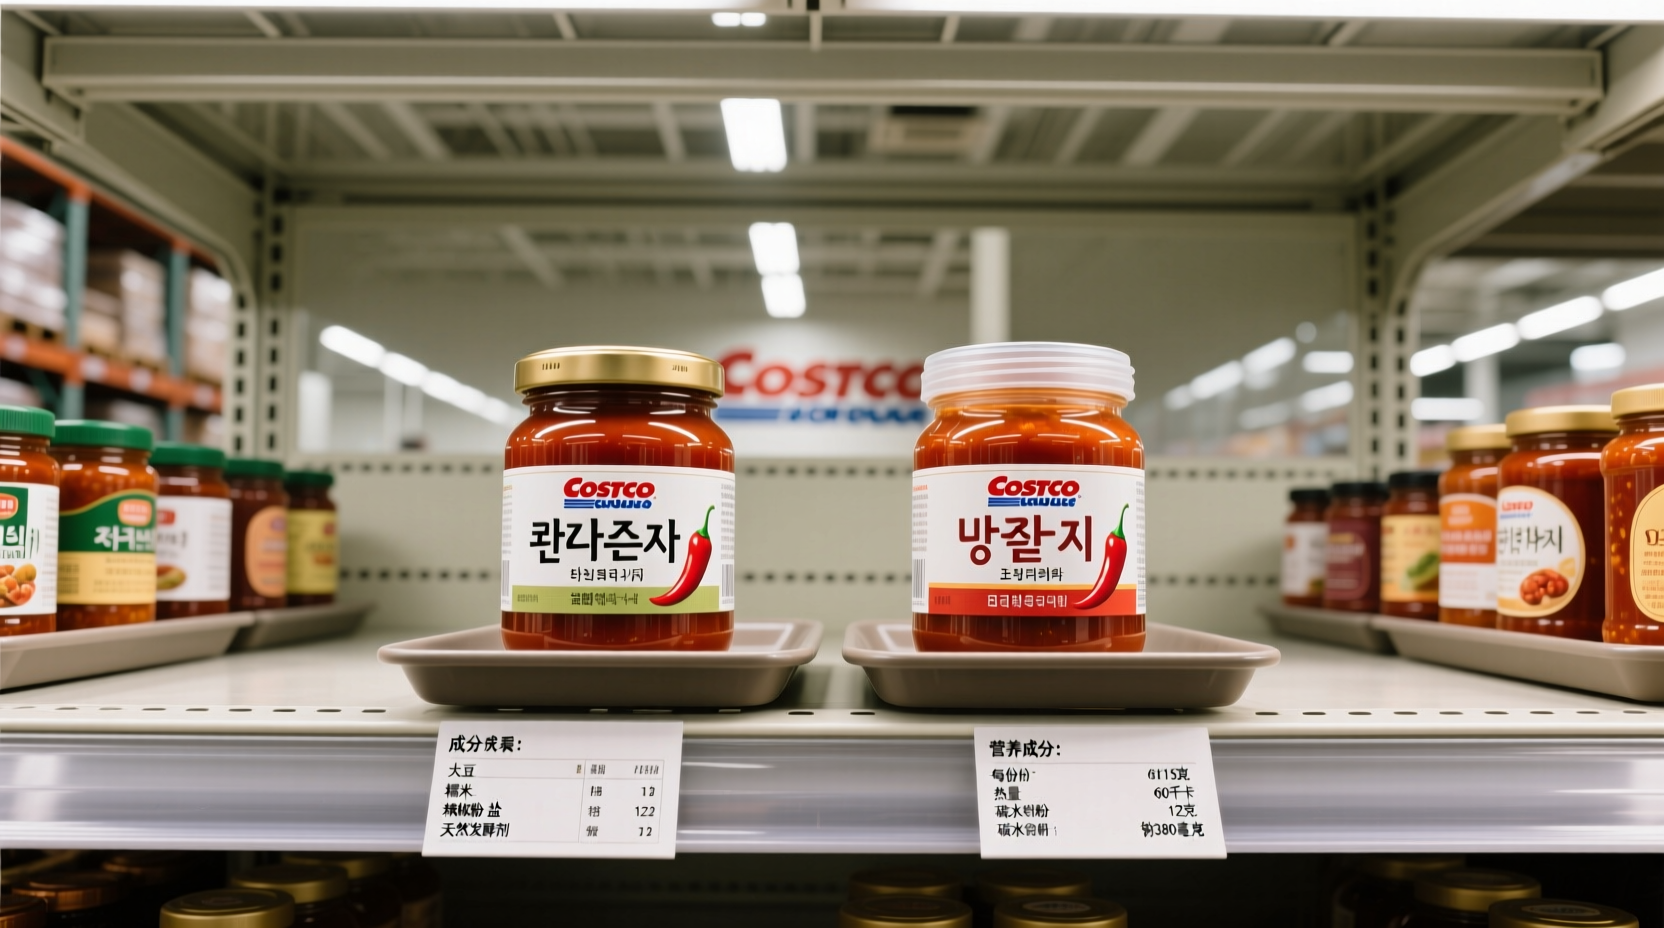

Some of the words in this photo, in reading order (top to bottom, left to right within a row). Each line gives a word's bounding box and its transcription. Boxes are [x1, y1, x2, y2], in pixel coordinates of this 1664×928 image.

[720, 351, 924, 399] COSTCO
[563, 477, 655, 498] COSTCO
[987, 475, 1080, 497] COSTCO
[989, 738, 1061, 758] 营养成分:
[448, 762, 476, 778] 大豆
